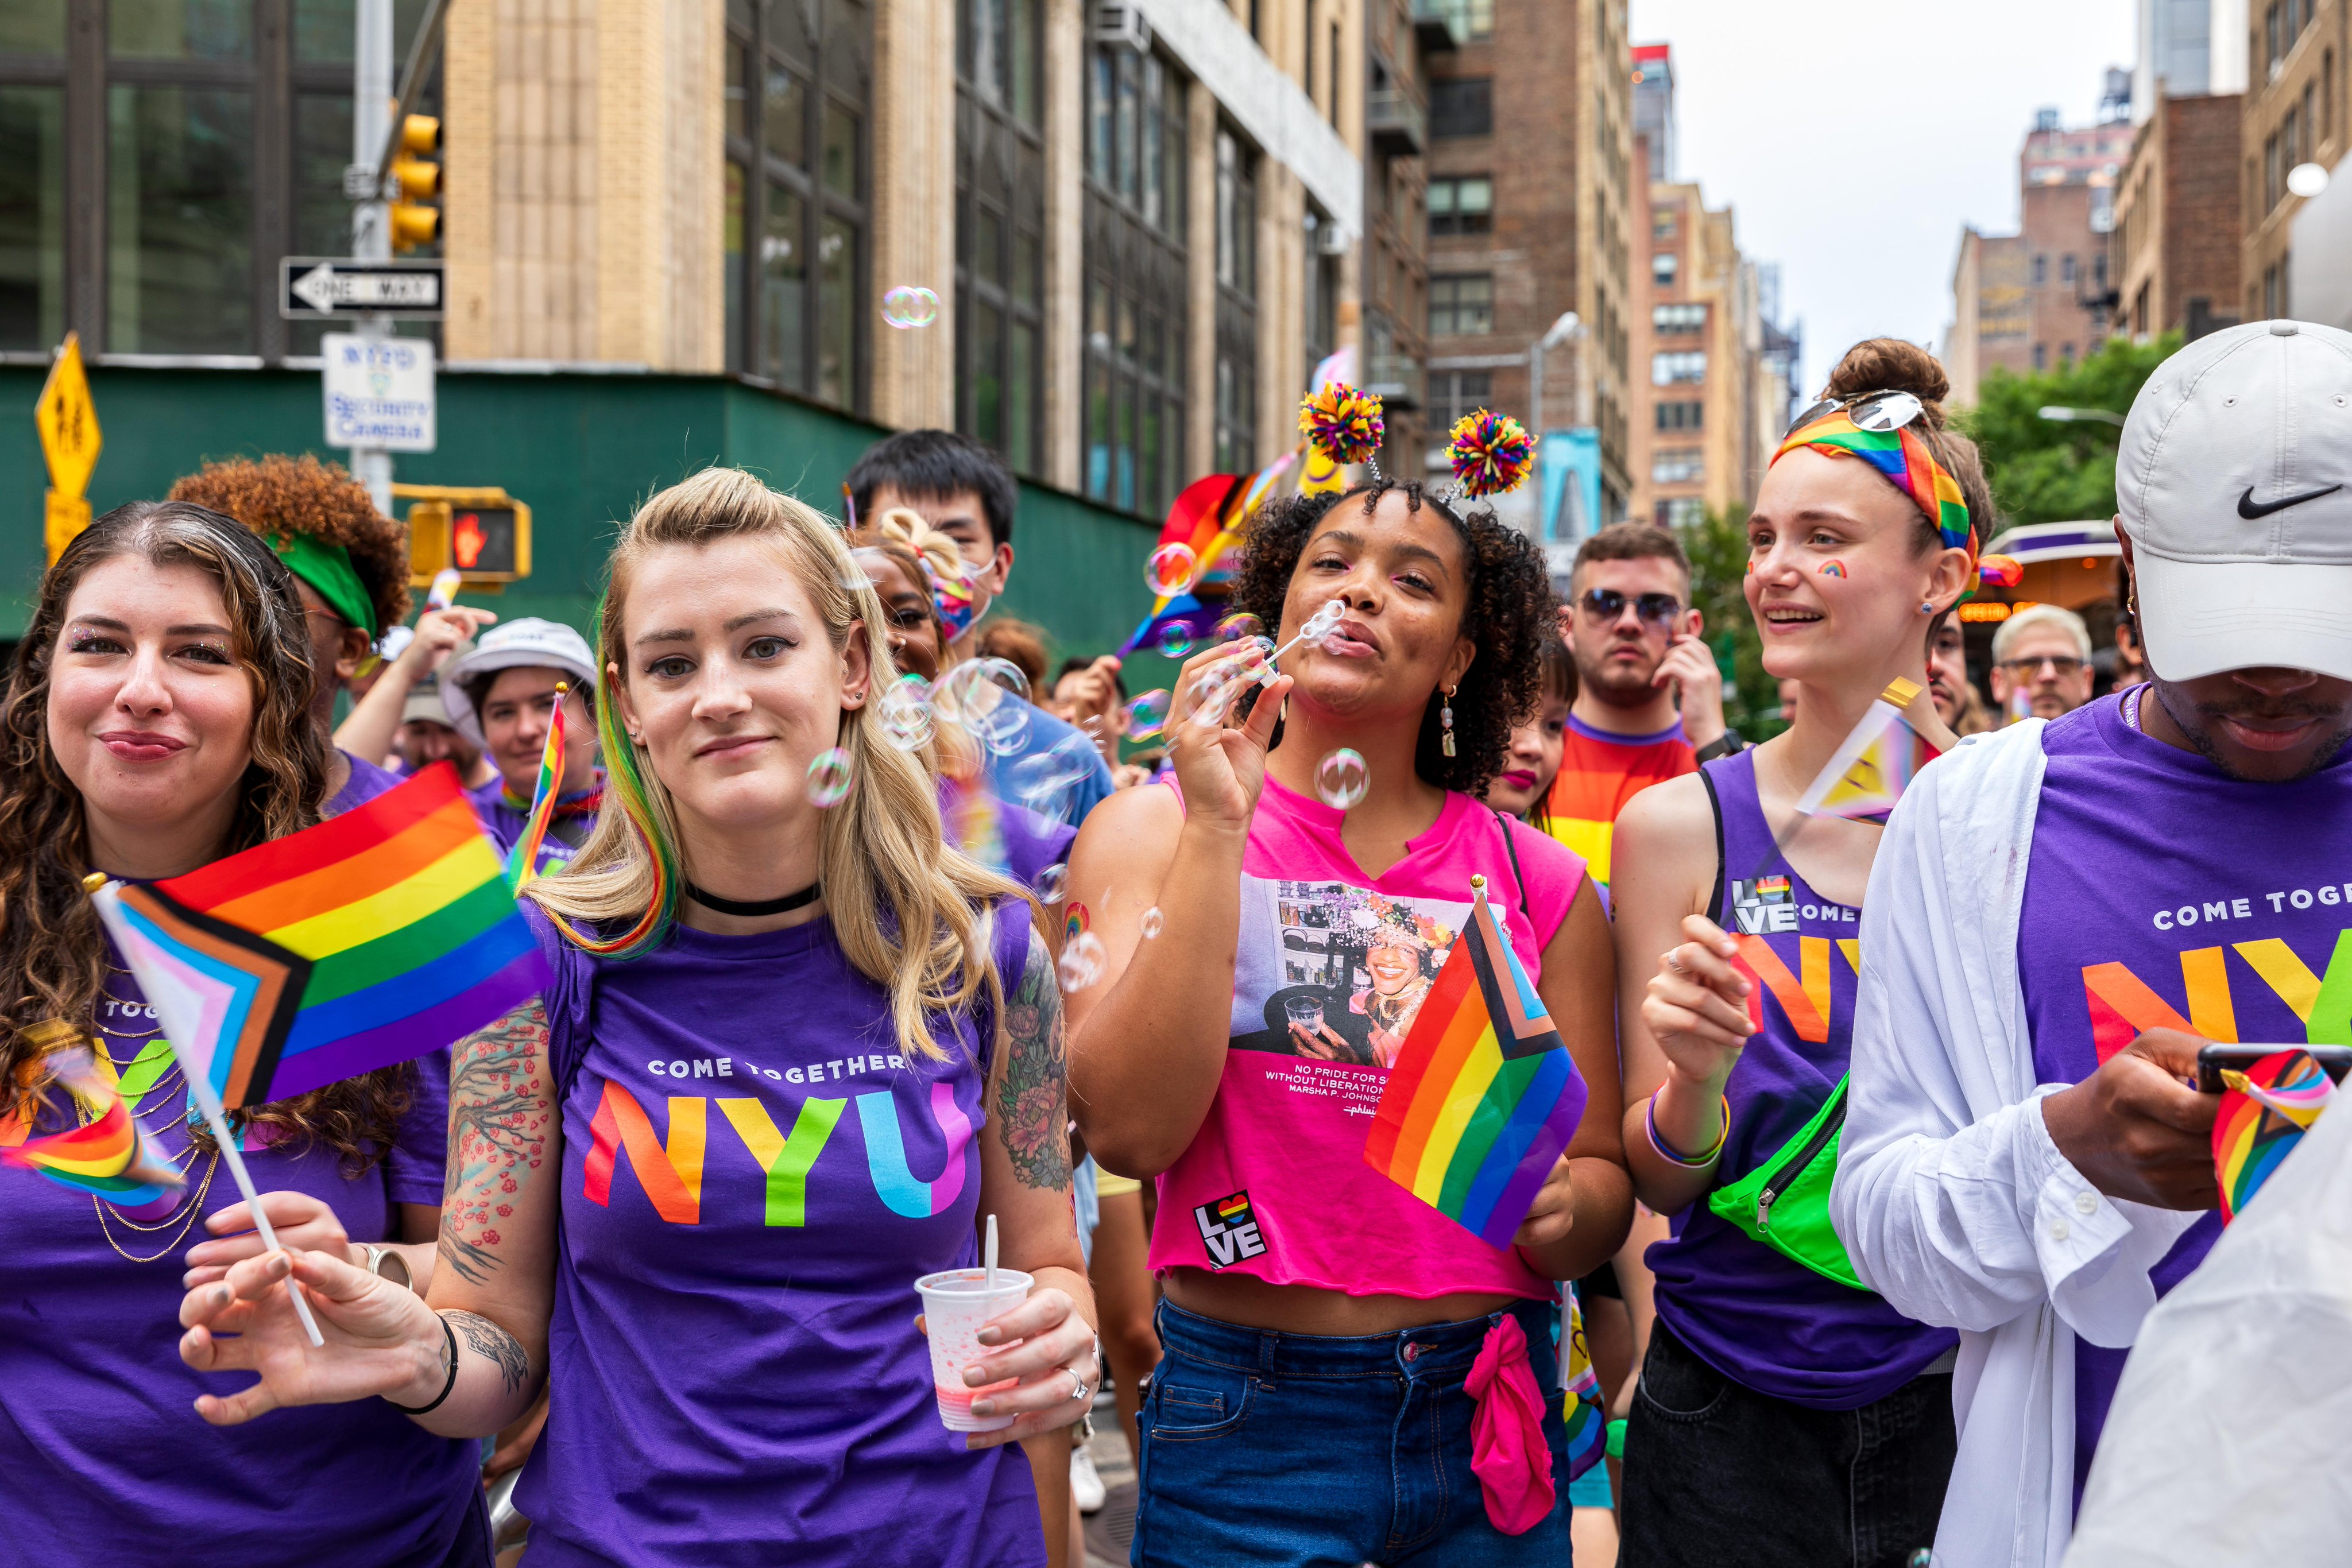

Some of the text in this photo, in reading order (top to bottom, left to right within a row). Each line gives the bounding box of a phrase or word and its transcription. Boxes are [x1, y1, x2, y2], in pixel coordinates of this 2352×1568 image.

[311, 274, 425, 303] ONE WAY
[342, 346, 417, 371] NYPD
[1795, 904, 1855, 922] OME
[2153, 898, 2252, 930] COME
[647, 1055, 907, 1084] COME TOGETHER
[1266, 1071, 1317, 1085] WITHOUT
[1295, 1064, 1311, 1074] NO
[1314, 1067, 1349, 1079] PRIDE
[1352, 1073, 1376, 1083] FOR
[1289, 1084, 1328, 1096] MARSHA
[583, 1079, 972, 1227] NYU
